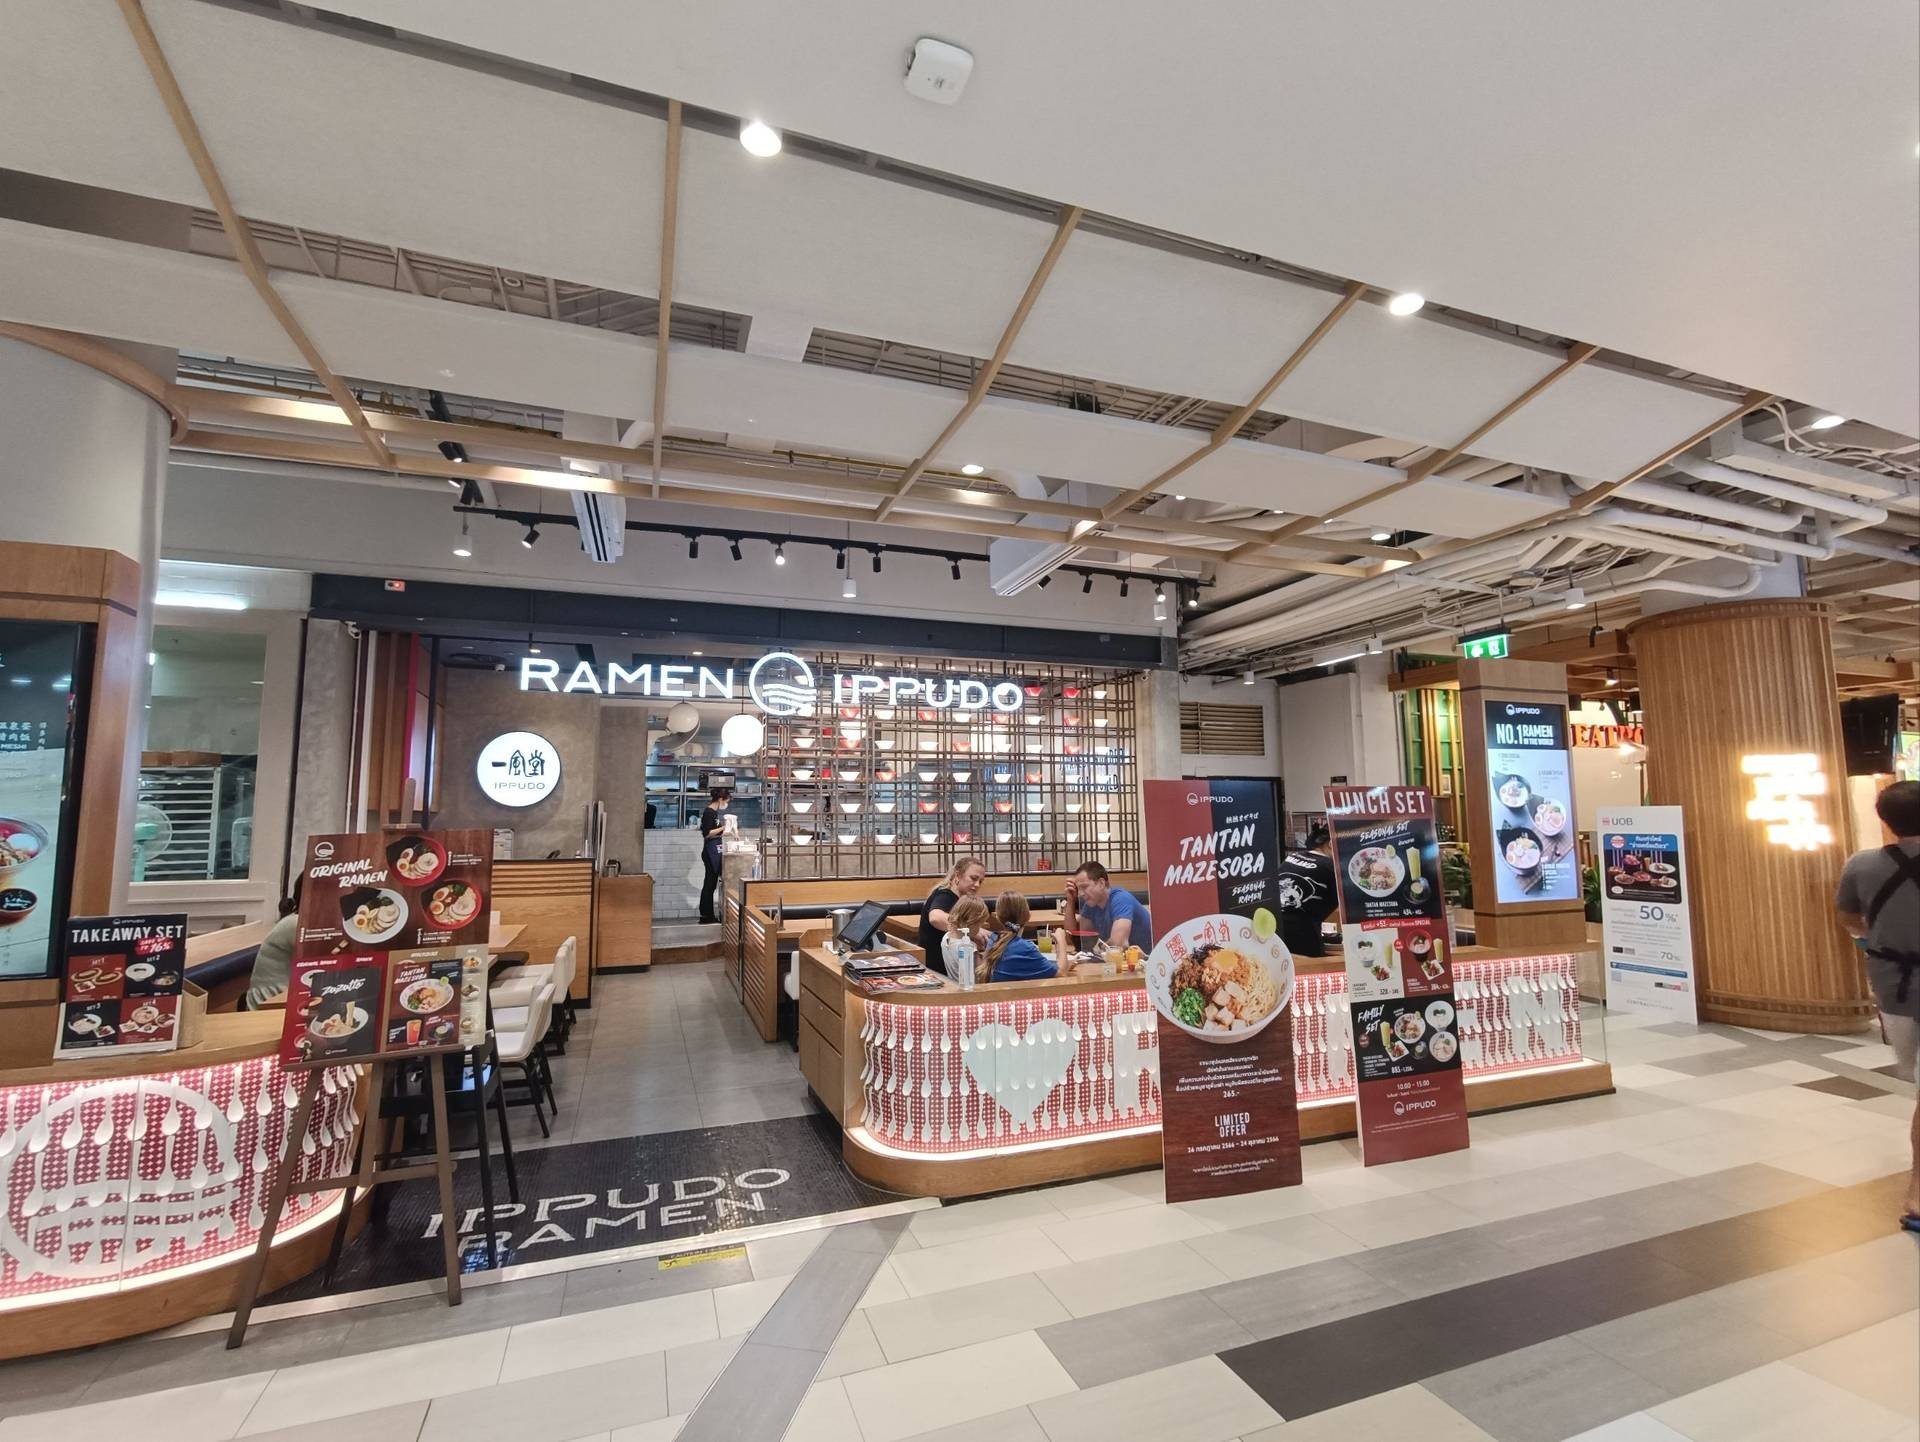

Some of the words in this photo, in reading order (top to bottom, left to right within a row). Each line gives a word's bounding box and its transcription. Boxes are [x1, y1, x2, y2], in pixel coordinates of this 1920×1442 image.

[519, 657, 734, 699] RAMEN
[832, 673, 1024, 711] IPPUDO
[1515, 706, 1540, 715] IPPUDO
[1496, 723, 1523, 745] NO.1
[1522, 725, 1553, 738] RAMEN
[493, 780, 546, 791] IPPUDO
[1199, 795, 1234, 804] IPPUDO
[1329, 791, 1391, 815] LUNCH
[1396, 790, 1425, 814] SET
[1611, 817, 1633, 826] UOB
[1179, 823, 1256, 861] TANTAN
[309, 858, 374, 879] ORIGINAL
[1163, 852, 1265, 887] MAZESOBA
[338, 870, 388, 889] RAMEN
[72, 928, 151, 943] TAKEAWAY
[155, 925, 184, 938] SET
[1365, 1019, 1380, 1035] SET
[1406, 1099, 1437, 1112] IPPUDO
[1214, 1112, 1250, 1127] LIMITED
[1219, 1123, 1247, 1138] OFFER
[421, 1167, 791, 1239] IPPUDO
[457, 1191, 766, 1258] RAMEN
